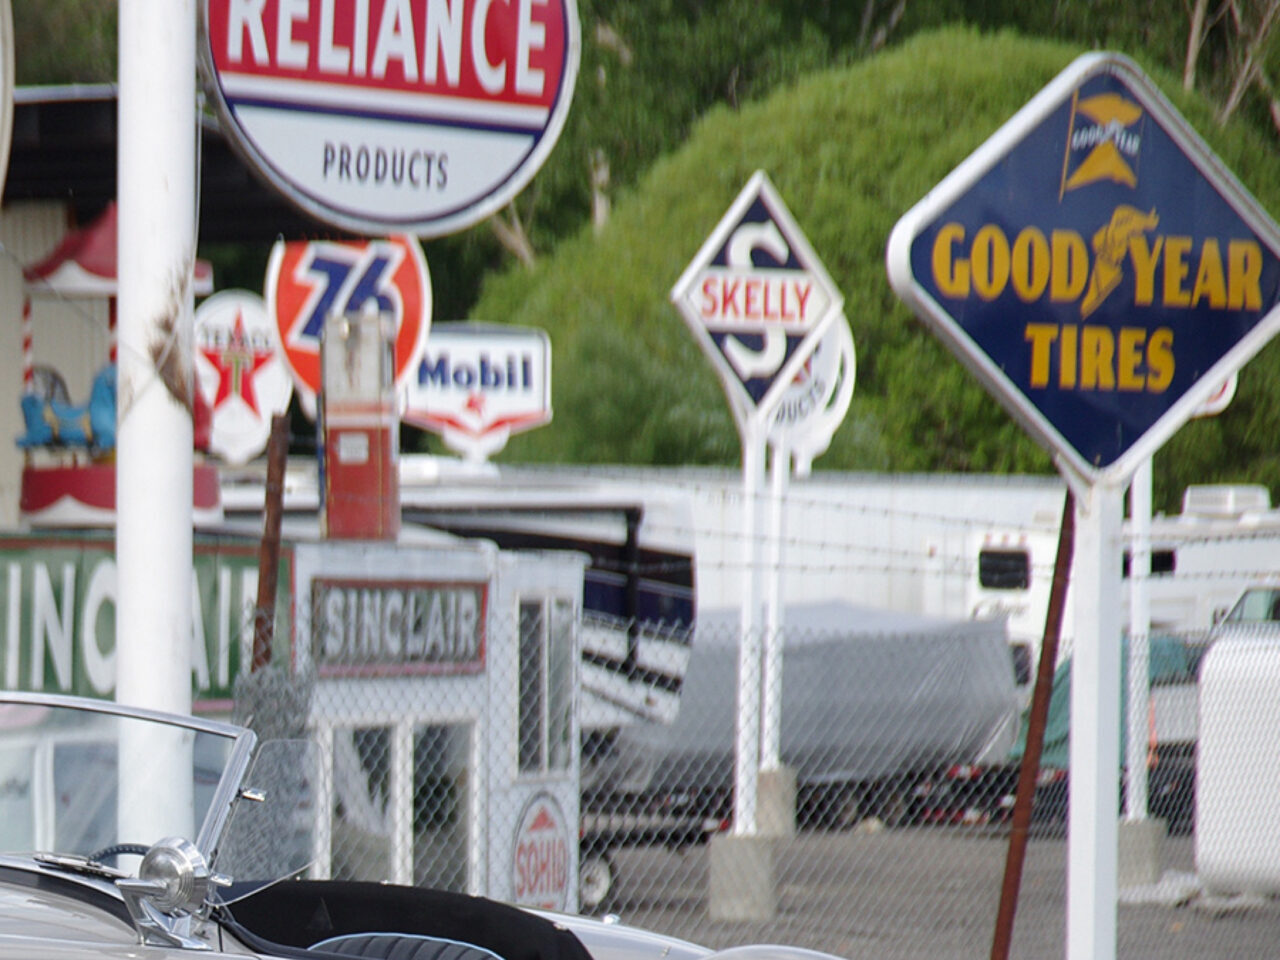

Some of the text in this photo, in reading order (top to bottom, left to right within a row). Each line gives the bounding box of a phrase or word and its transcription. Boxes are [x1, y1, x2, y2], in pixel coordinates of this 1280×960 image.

[226, 0, 547, 97] RELIANCE
[322, 142, 449, 188] PRODUCTS
[293, 246, 401, 345] 76
[701, 276, 814, 322] SKELLY
[417, 351, 533, 390] Mobil
[1025, 322, 1175, 393] TIRES
[325, 587, 480, 657] SINCLAIR
[517, 839, 566, 897] SOHIO
